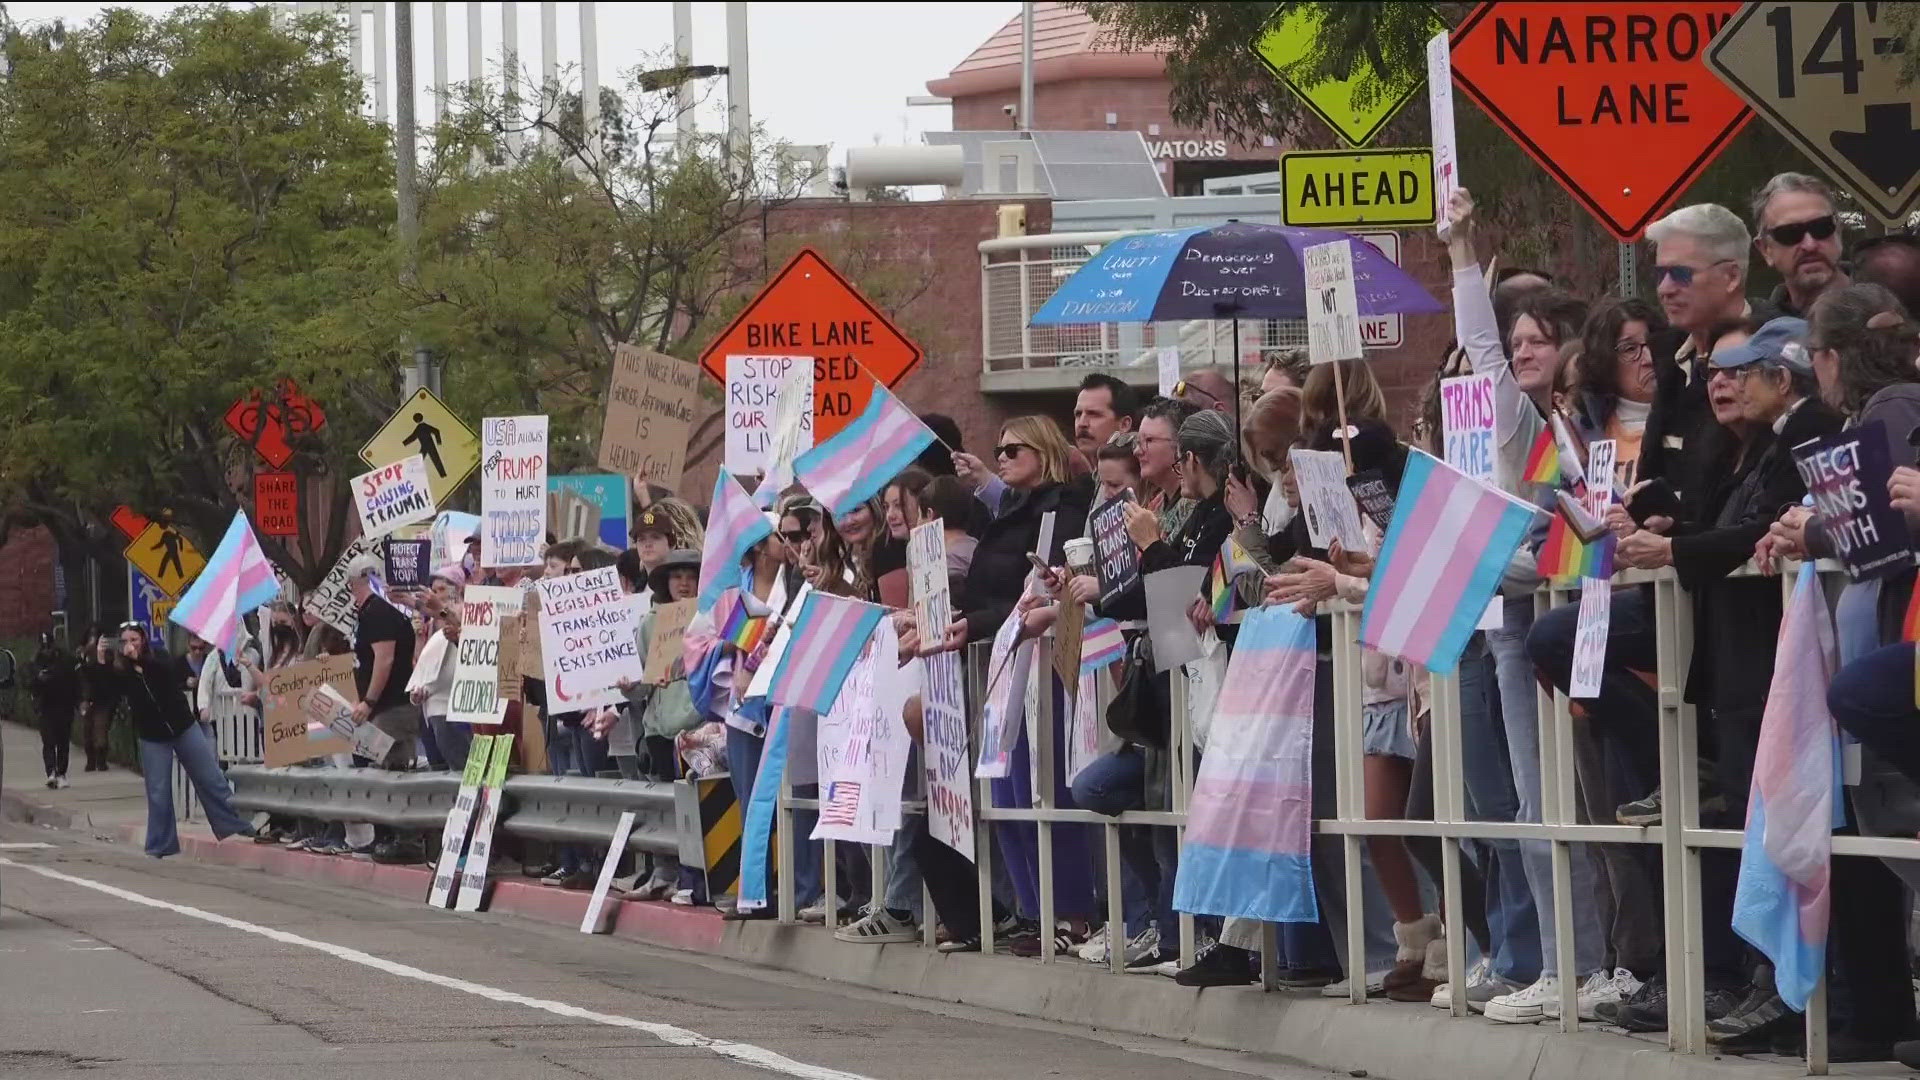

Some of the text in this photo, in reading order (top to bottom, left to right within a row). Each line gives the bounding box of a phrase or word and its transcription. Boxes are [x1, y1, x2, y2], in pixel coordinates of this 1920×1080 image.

[1557, 83, 1690, 126] LANE
[1300, 170, 1419, 208] AHEAD
[1321, 287, 1337, 315] NOT
[747, 321, 874, 348] BIKE LANE
[620, 351, 640, 373] THIS
[743, 357, 792, 379] STOP
[1443, 376, 1494, 432] TRANS
[485, 419, 544, 446] USA ALLOWS
[635, 416, 651, 439] IS
[609, 443, 640, 473] HEALTH
[1449, 431, 1493, 474] CARE
[363, 463, 403, 497] STOP
[495, 455, 543, 482] TRUMP
[259, 481, 297, 493] SHARE
[366, 480, 415, 511] CAUSING
[495, 488, 506, 499] TO
[516, 485, 541, 501] HURT
[267, 498, 289, 510] THE
[366, 488, 431, 528] TRAUMA!
[263, 516, 294, 528] ROAD
[488, 509, 540, 537] TRANS
[1093, 498, 1124, 539] PROTECT
[390, 543, 421, 555] PROTECT
[491, 536, 535, 564] KIDS
[1097, 524, 1128, 561] TRANS
[392, 556, 418, 569] TRANS
[393, 569, 418, 582] YOUTH
[1101, 547, 1132, 584] YOUTH
[542, 571, 615, 603] YOU CAN'T
[546, 589, 621, 617] LEGISLATE
[564, 629, 617, 653] OUT OF
[271, 721, 307, 744] Saves
[925, 706, 964, 755] FOCUSED
[939, 751, 957, 781] ON
[931, 784, 969, 831] WRONG
